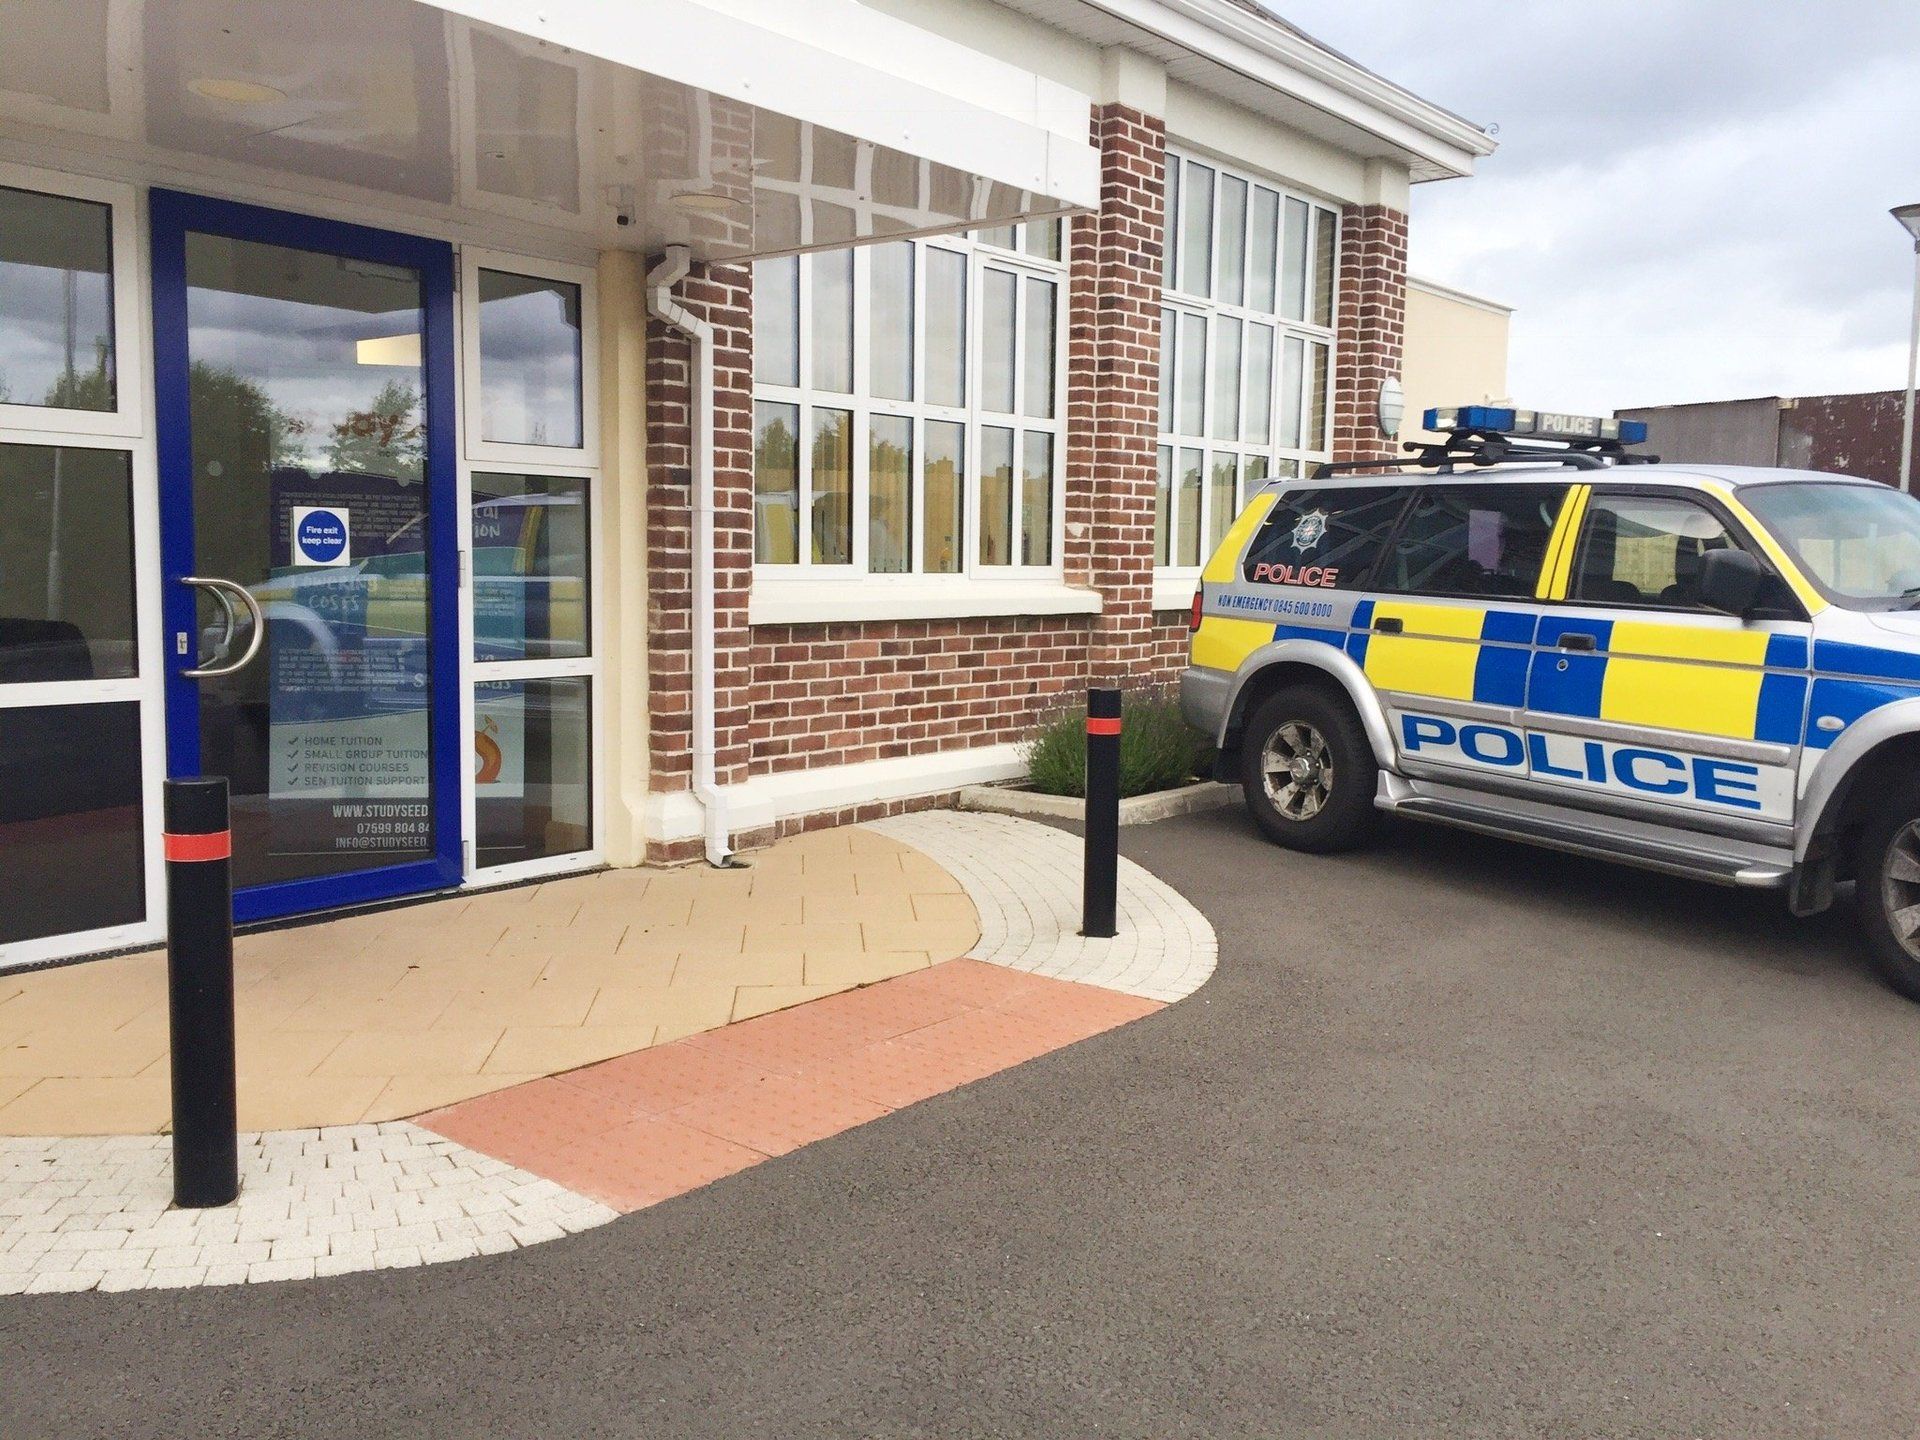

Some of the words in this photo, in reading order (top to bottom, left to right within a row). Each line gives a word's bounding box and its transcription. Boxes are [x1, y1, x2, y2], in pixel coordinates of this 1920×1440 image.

[1542, 414, 1594, 435] POLICE
[306, 525, 322, 534] Fire
[323, 525, 338, 534] exit
[302, 537, 322, 546] keep
[322, 536, 343, 545] clear
[1253, 563, 1338, 588] POLICE
[1218, 594, 1232, 607] NON
[1232, 595, 1273, 612] EMERGENCY
[1273, 599, 1293, 614] 0845
[1294, 601, 1310, 615] 600
[1311, 602, 1333, 618] 8000
[304, 736, 336, 746] HOME
[341, 736, 383, 746] TUITION
[304, 750, 344, 759] SMALL
[345, 750, 383, 759] GROUP
[387, 750, 428, 759] TUITION
[1401, 713, 1761, 811] POLICE
[304, 763, 356, 773] REVISION
[359, 763, 410, 773] COURSES
[304, 776, 327, 786] SEN
[330, 776, 373, 786] TUITION
[376, 776, 426, 786] SUPPORT
[332, 804, 429, 818] WWW.STUDYSEED
[394, 822, 415, 834] 804
